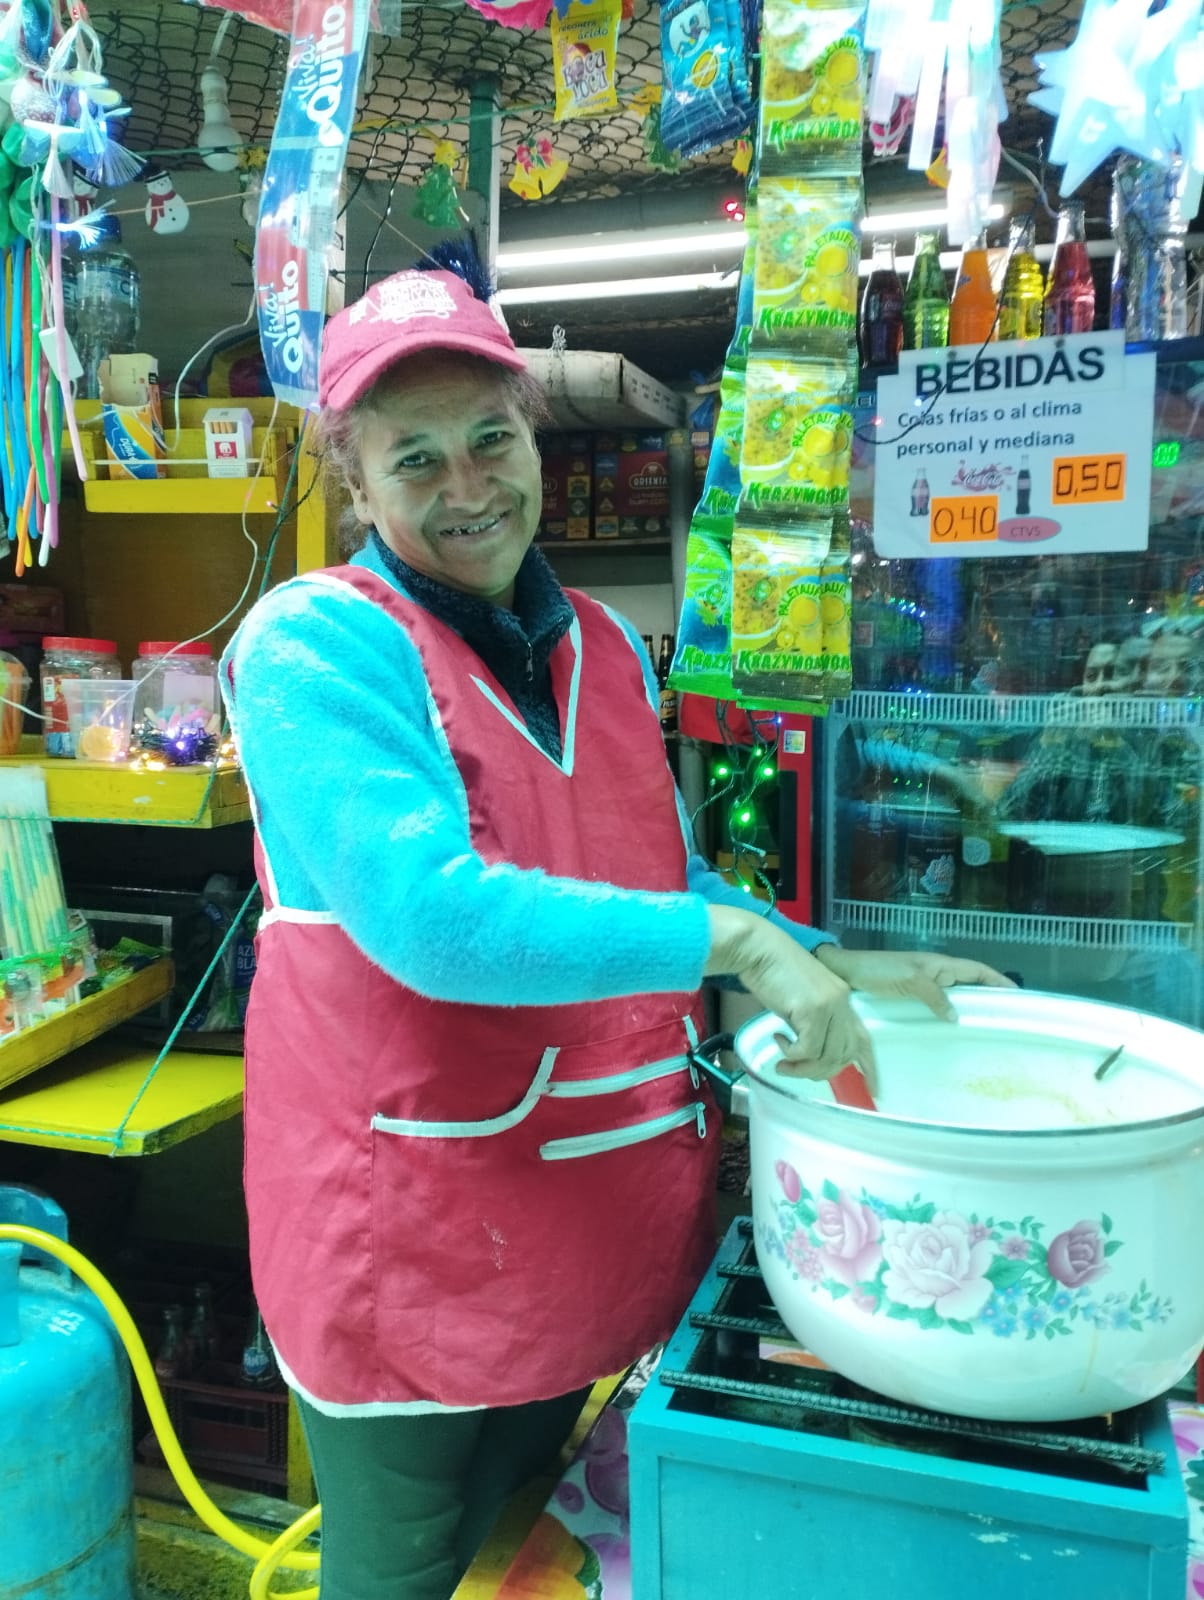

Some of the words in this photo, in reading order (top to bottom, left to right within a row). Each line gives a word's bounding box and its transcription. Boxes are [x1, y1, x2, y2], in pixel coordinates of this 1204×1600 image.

[306, 5, 346, 123] Quito
[258, 282, 287, 348] Viva!
[281, 260, 304, 374] Quito
[915, 347, 1106, 397] BEBIDAS
[898, 410, 944, 428] Colas
[950, 407, 988, 424] frías
[994, 408, 1005, 421] o
[1010, 402, 1026, 420] al
[1032, 400, 1083, 418] clima
[897, 436, 973, 459] personal
[979, 439, 989, 455] y
[994, 431, 1076, 450] mediana
[633, 475, 669, 487] ORIENTA
[1056, 462, 1122, 498] 0,50
[933, 506, 997, 539] 0,40
[237, 959, 257, 970] BLA
